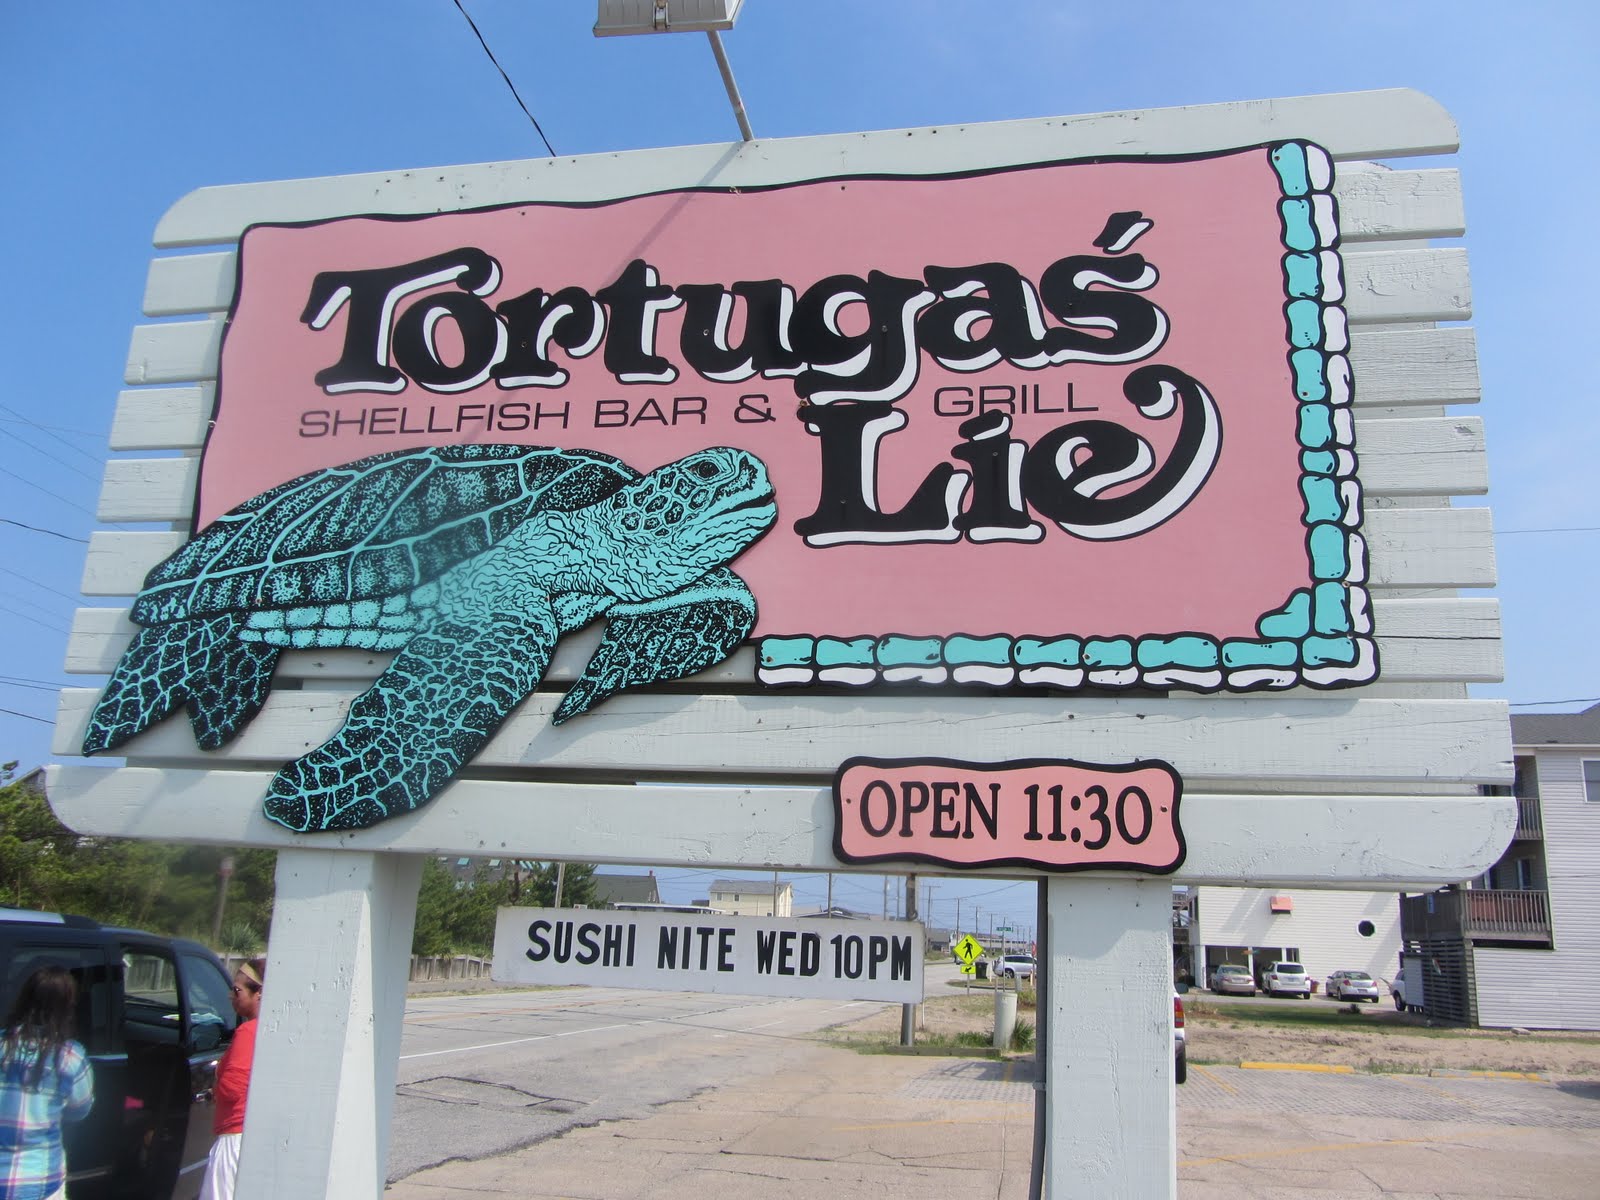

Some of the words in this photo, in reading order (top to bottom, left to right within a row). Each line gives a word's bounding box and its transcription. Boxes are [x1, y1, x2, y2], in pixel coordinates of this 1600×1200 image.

[298, 402, 570, 438] SHELLFISH
[593, 396, 707, 428] BAR
[733, 394, 777, 424] &
[933, 382, 1100, 417] GRILL
[793, 364, 1224, 549] Lie
[859, 779, 1002, 840] OPEN
[1023, 784, 1153, 850] 11:30
[525, 919, 637, 968] SUSHI
[657, 926, 736, 973] NITE
[756, 930, 821, 977] WED
[830, 934, 912, 982] 10PM
